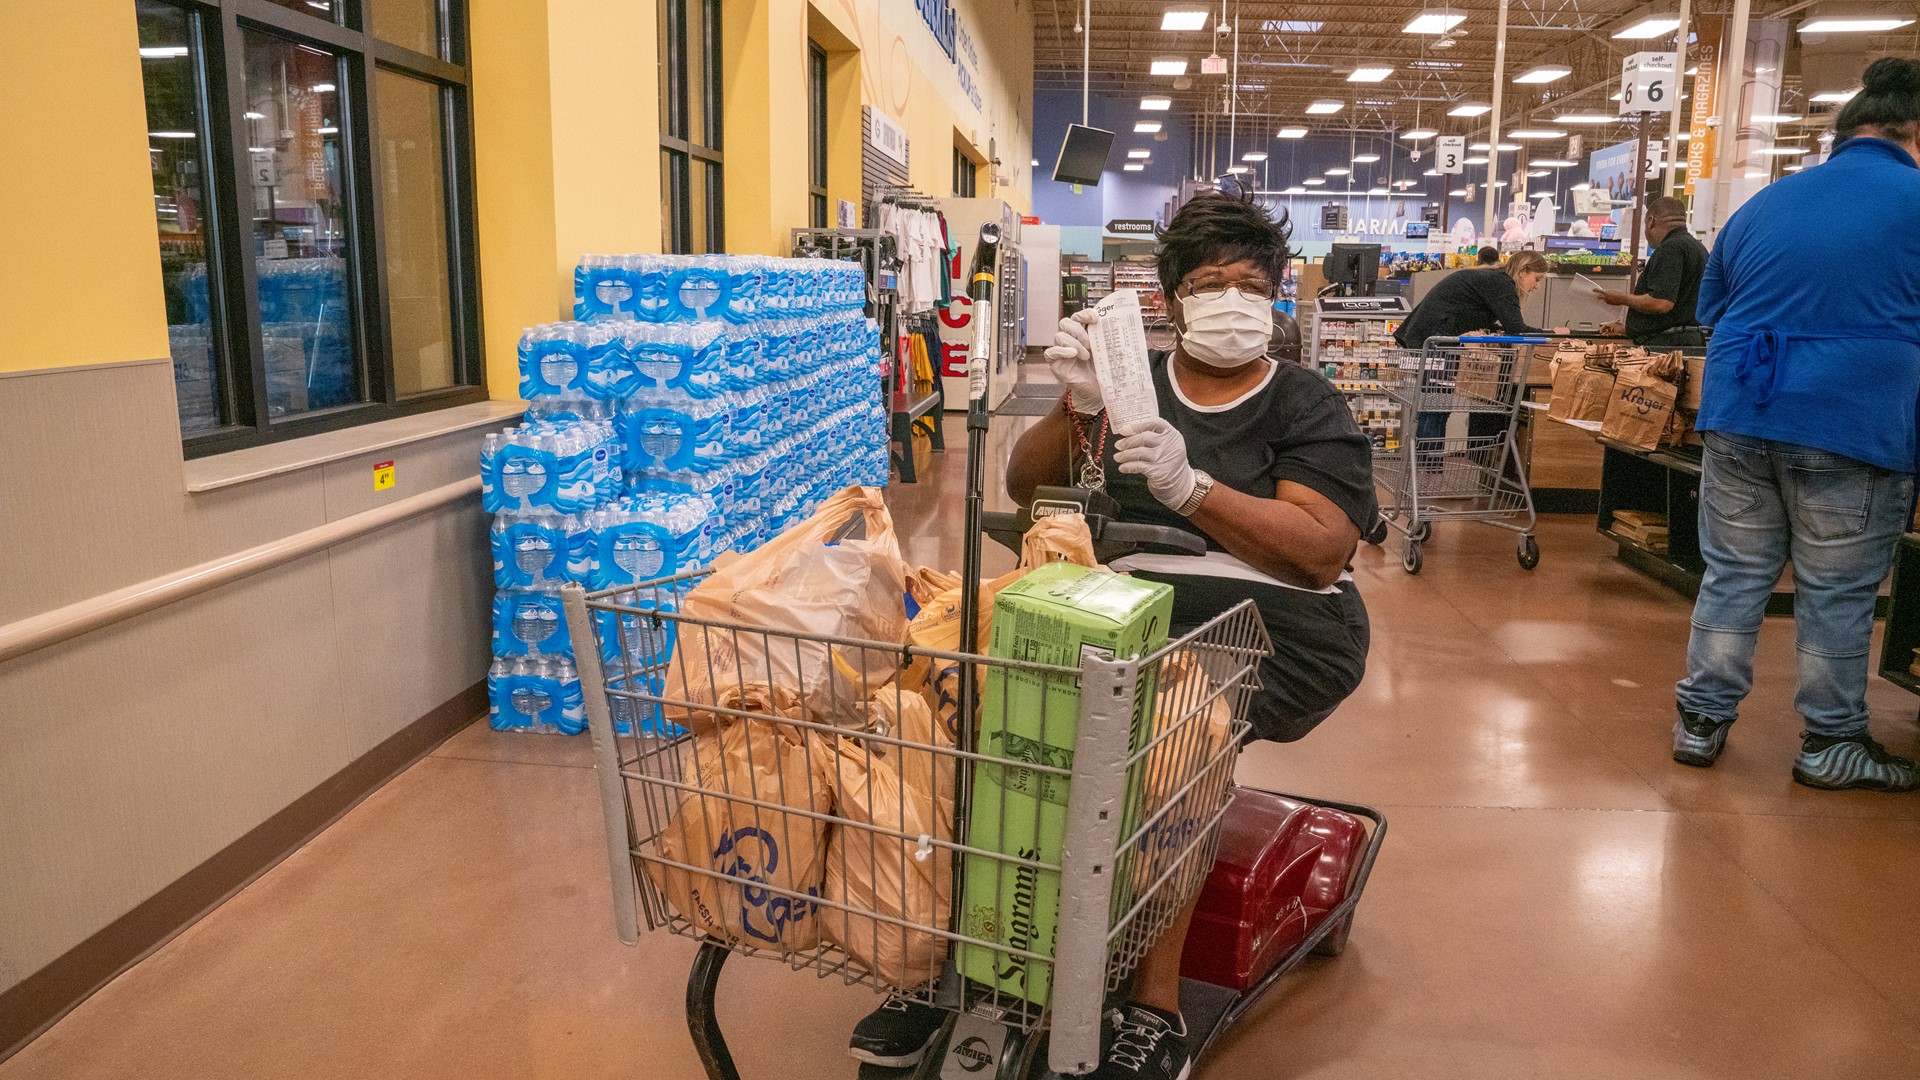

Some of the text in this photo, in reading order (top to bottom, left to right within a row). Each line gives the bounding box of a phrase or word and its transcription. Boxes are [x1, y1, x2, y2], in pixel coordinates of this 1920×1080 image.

[1643, 61, 1672, 69] checkout
[1625, 81, 1632, 105] 6
[1647, 79, 1664, 103] 6
[1688, 44, 1714, 185] BOOKS & MAGAZINES
[1445, 153, 1456, 168] 3
[1645, 158, 1653, 173] 2
[1114, 222, 1152, 231] restrooms
[1621, 386, 1663, 415] Kroger
